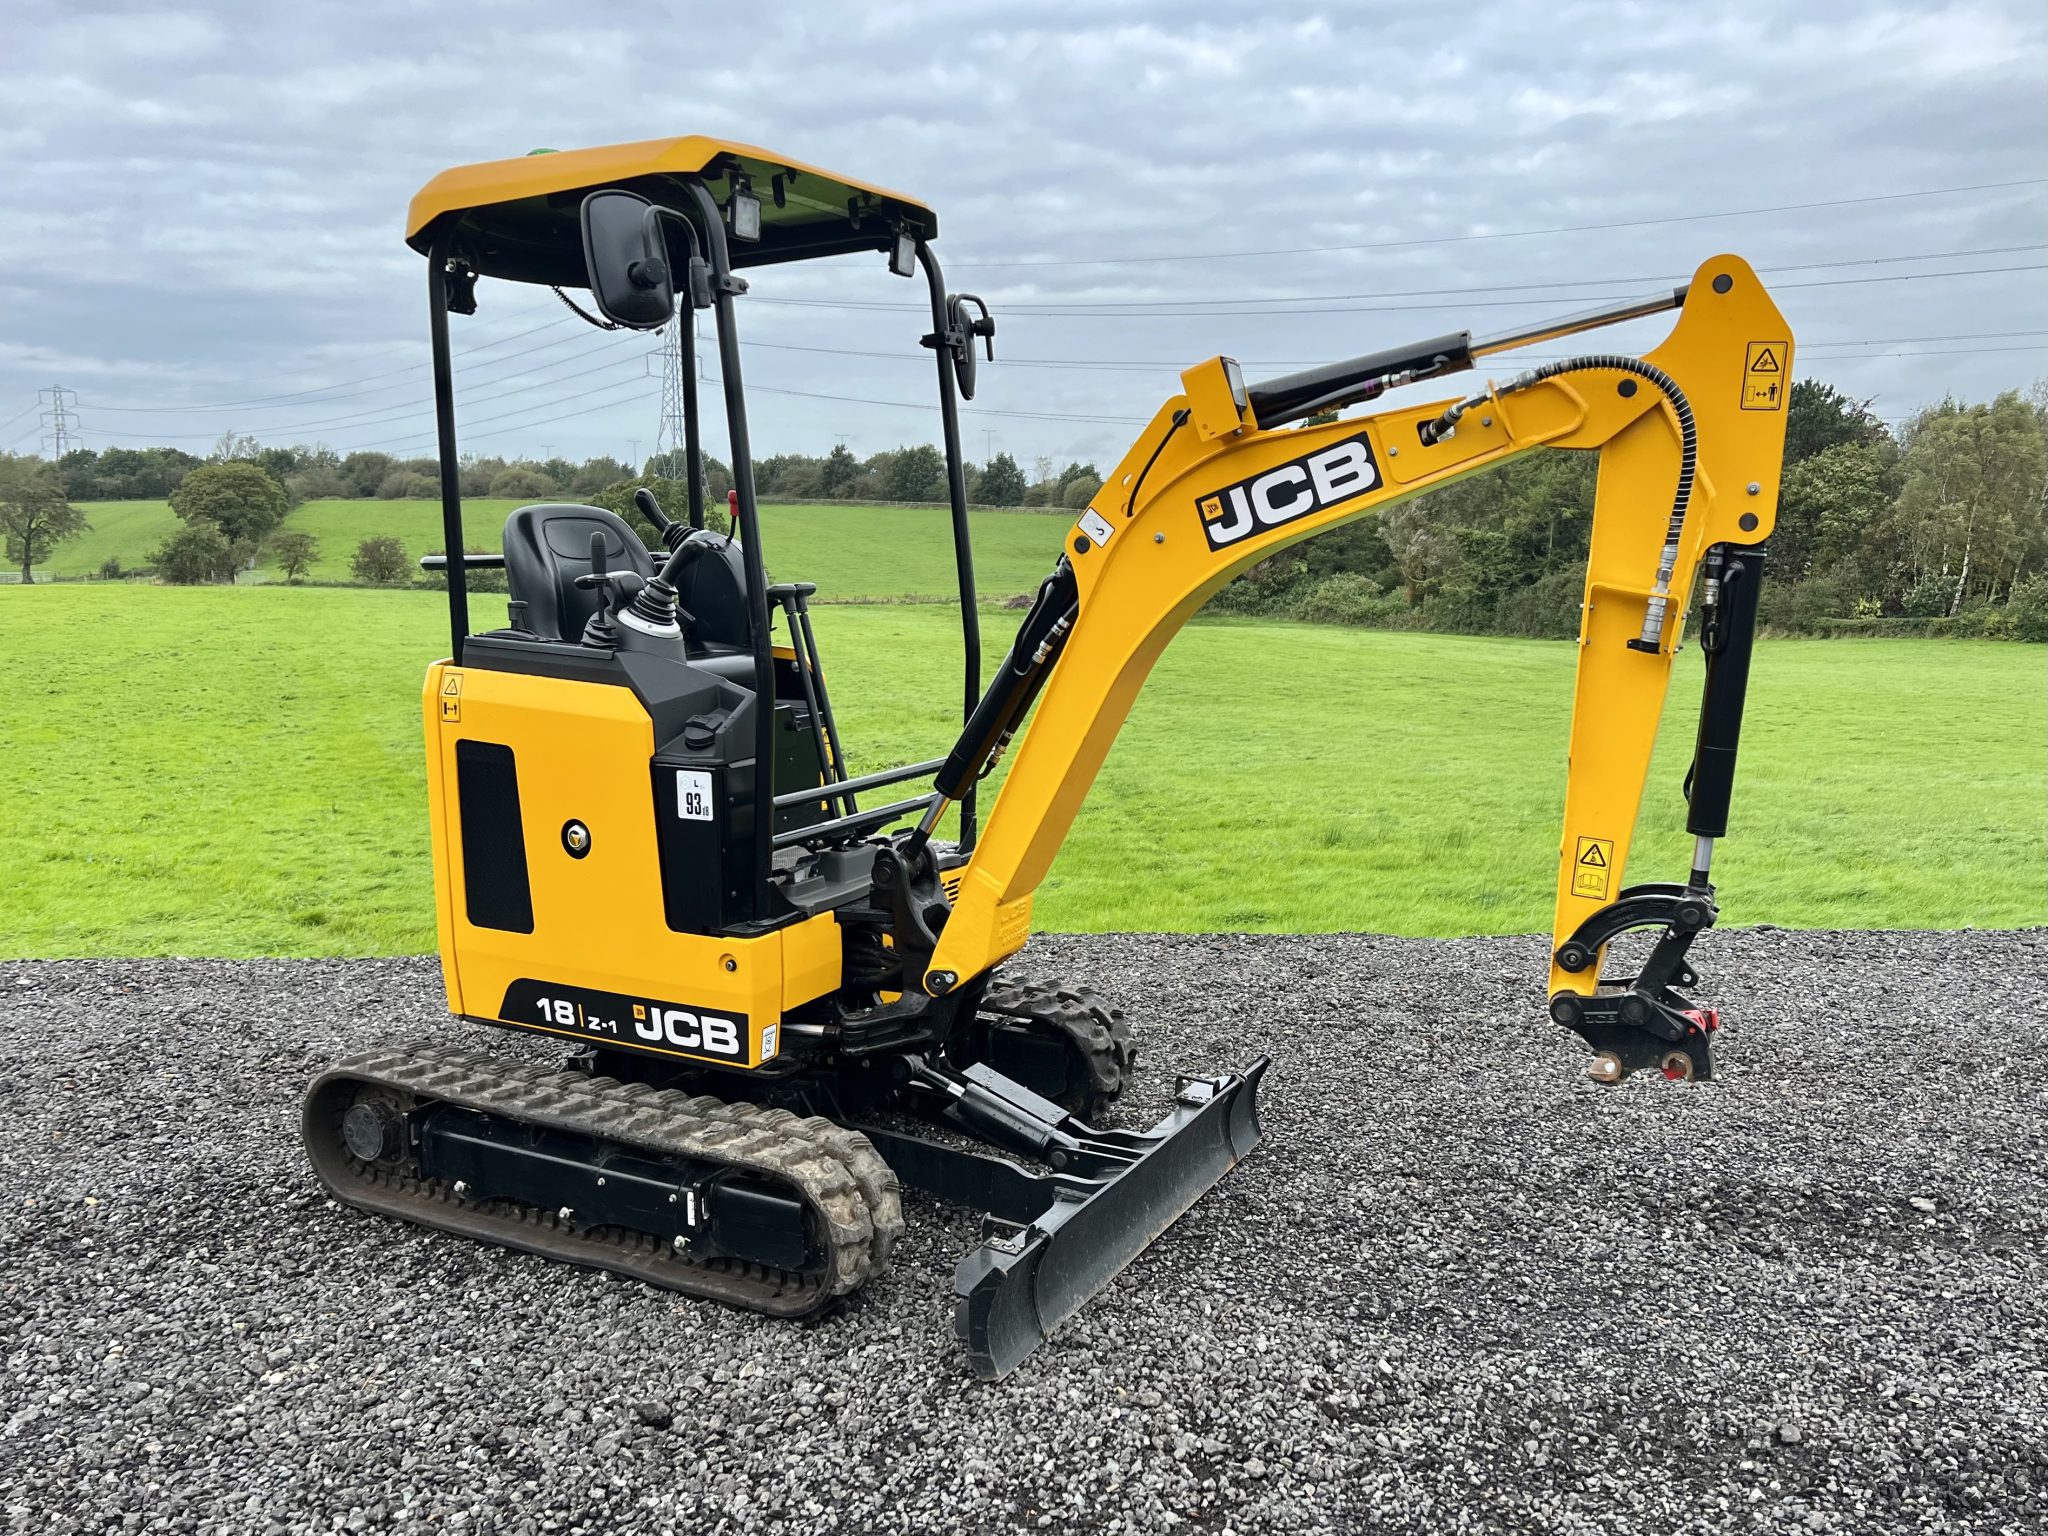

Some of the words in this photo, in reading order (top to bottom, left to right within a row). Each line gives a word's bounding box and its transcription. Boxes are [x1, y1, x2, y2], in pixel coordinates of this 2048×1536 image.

[1208, 441, 1376, 543] JCB
[686, 792, 701, 815] 93
[694, 779, 699, 788] L
[536, 998, 575, 1026] 18
[634, 1007, 740, 1055] JCB
